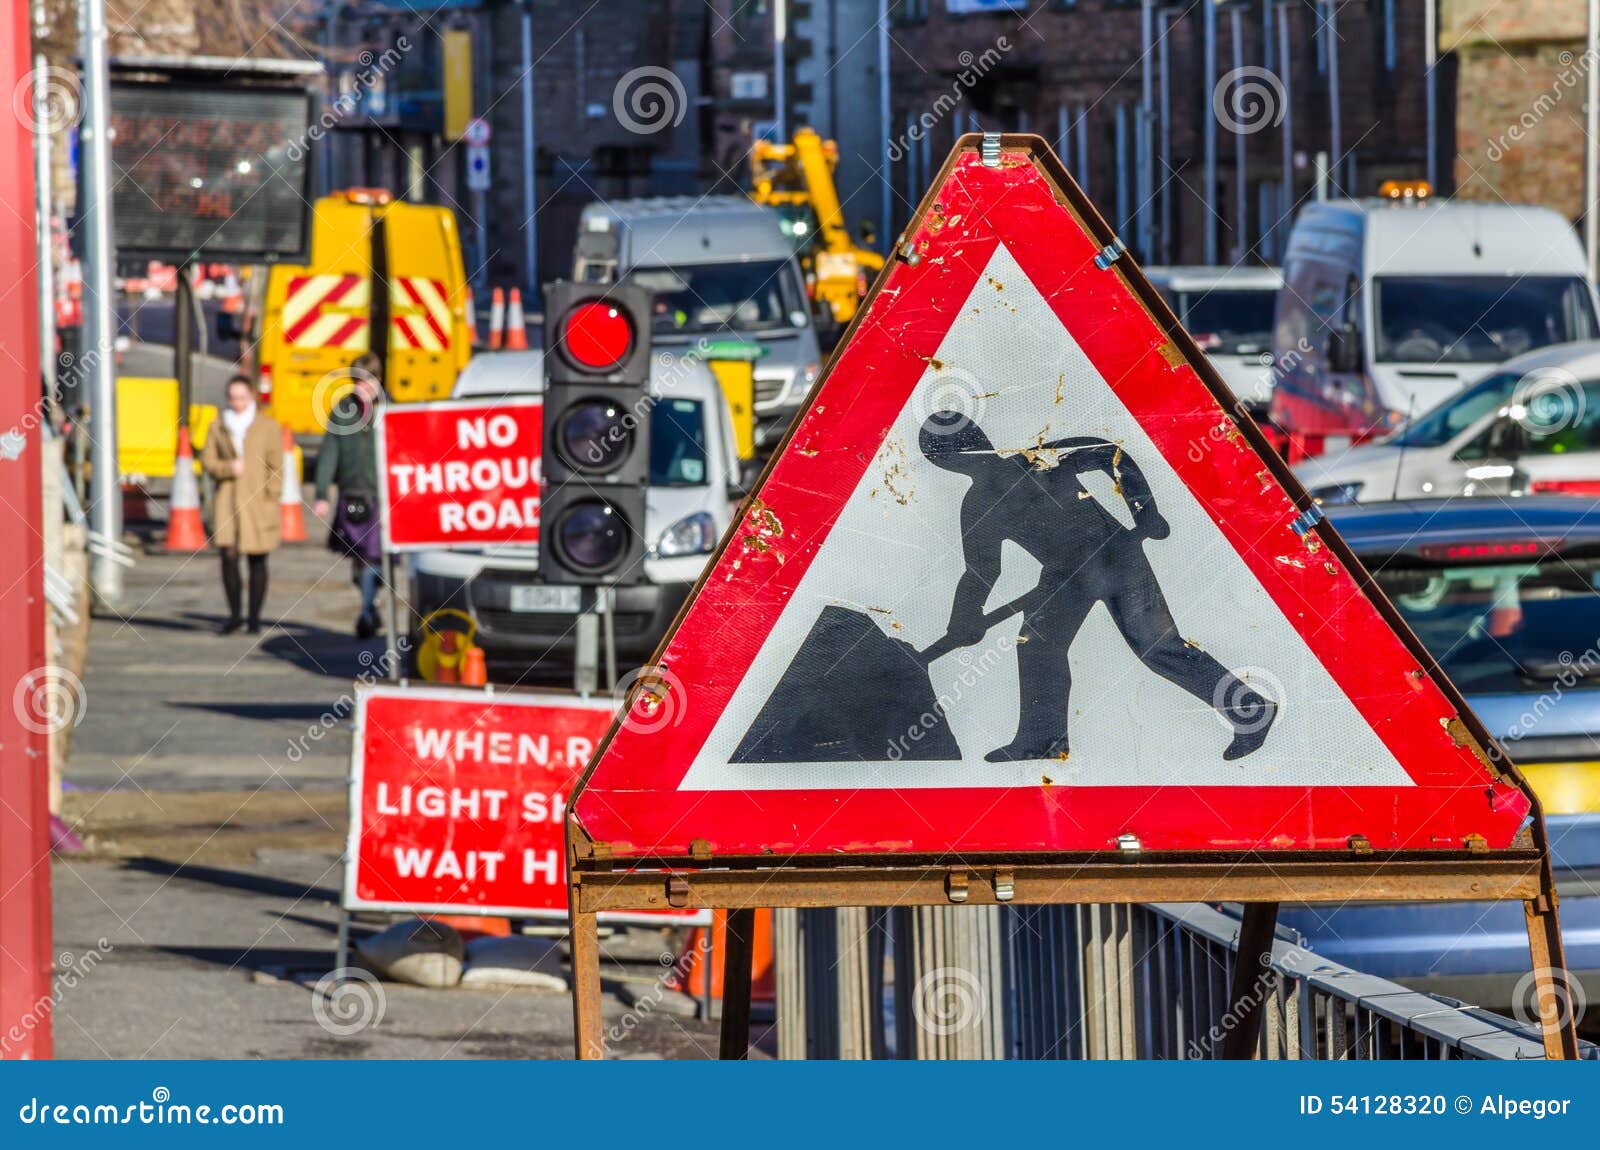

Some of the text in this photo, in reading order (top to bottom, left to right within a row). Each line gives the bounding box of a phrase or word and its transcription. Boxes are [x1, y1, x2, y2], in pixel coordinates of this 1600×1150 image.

[457, 415, 518, 449] NO
[413, 726, 549, 766] WHEN
[376, 782, 508, 820] LIGHT
[393, 847, 505, 881] WAIT
